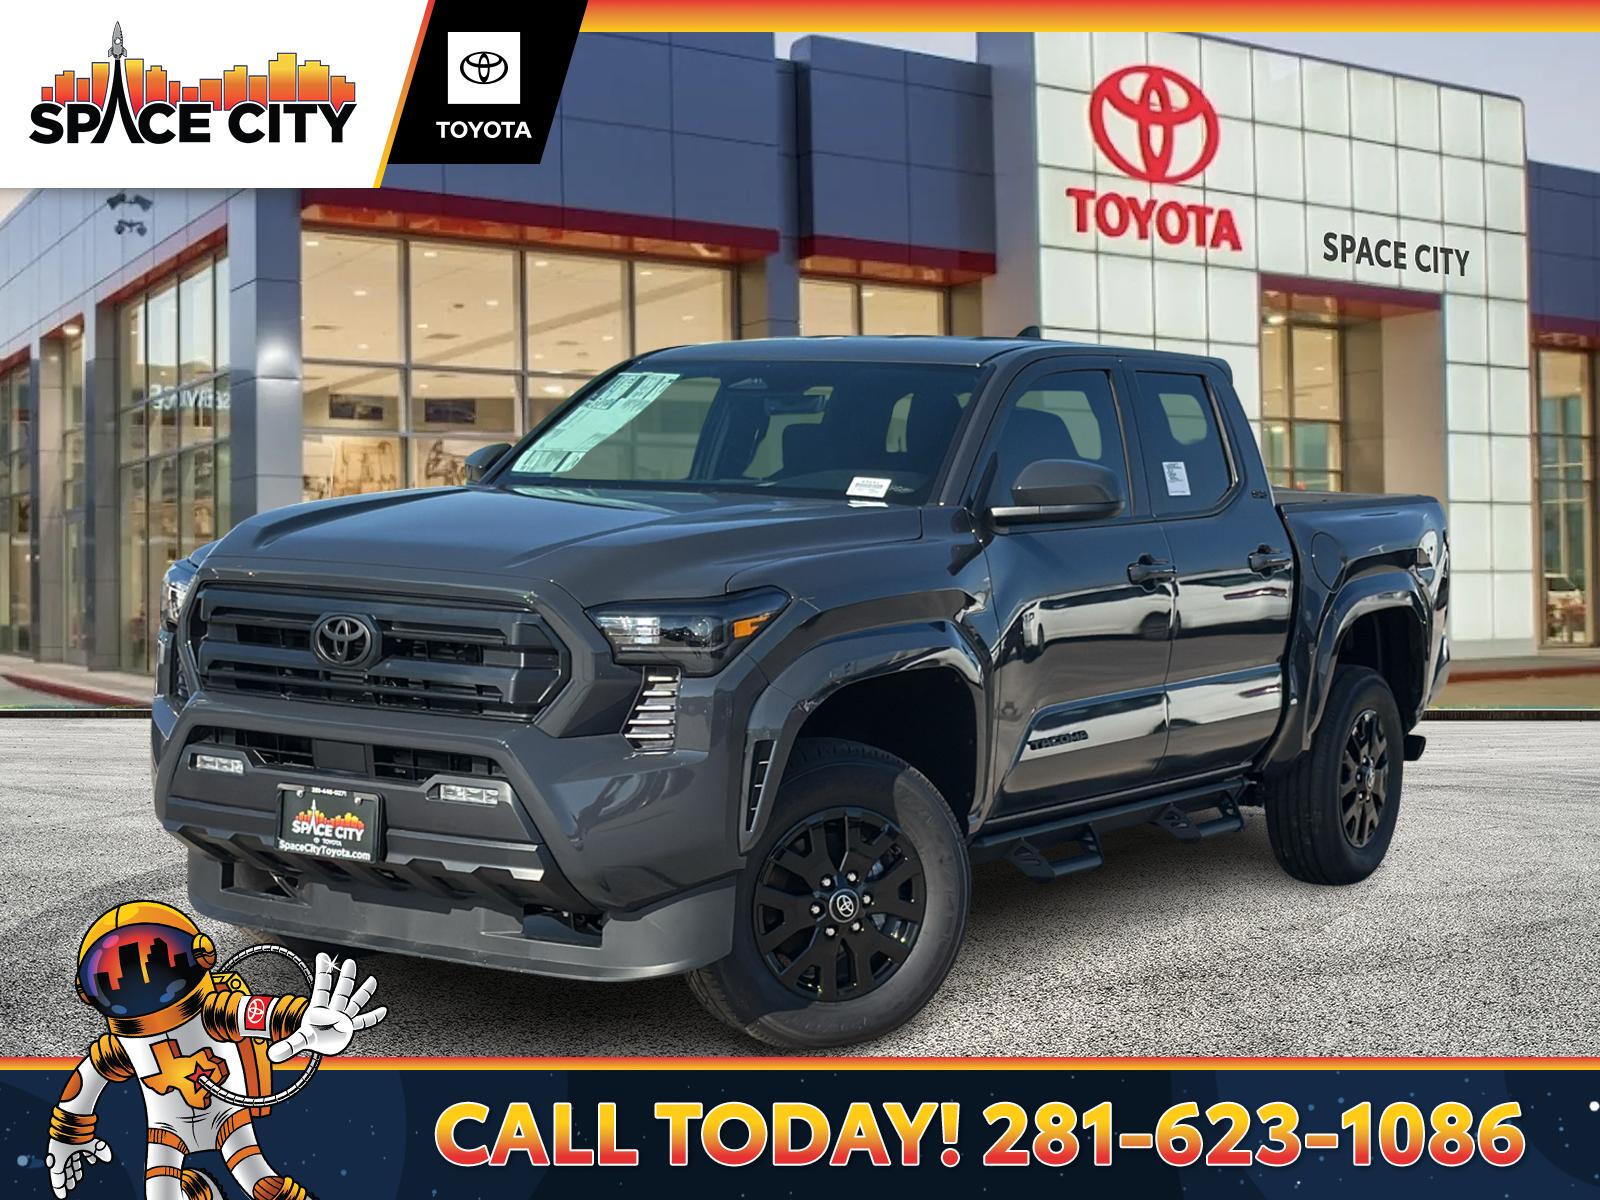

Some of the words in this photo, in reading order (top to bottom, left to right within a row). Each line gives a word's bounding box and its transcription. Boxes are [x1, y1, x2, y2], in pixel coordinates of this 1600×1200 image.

[1066, 188, 1243, 251] TOYOTA
[1323, 232, 1407, 271] SPACE
[1414, 244, 1471, 277] CITY
[1028, 730, 1088, 750] TACOMA
[292, 811, 333, 837] SPACE
[335, 827, 364, 841] CITY
[279, 840, 370, 860] SpaceCityToyota.com
[323, 838, 342, 846] TOYOTA
